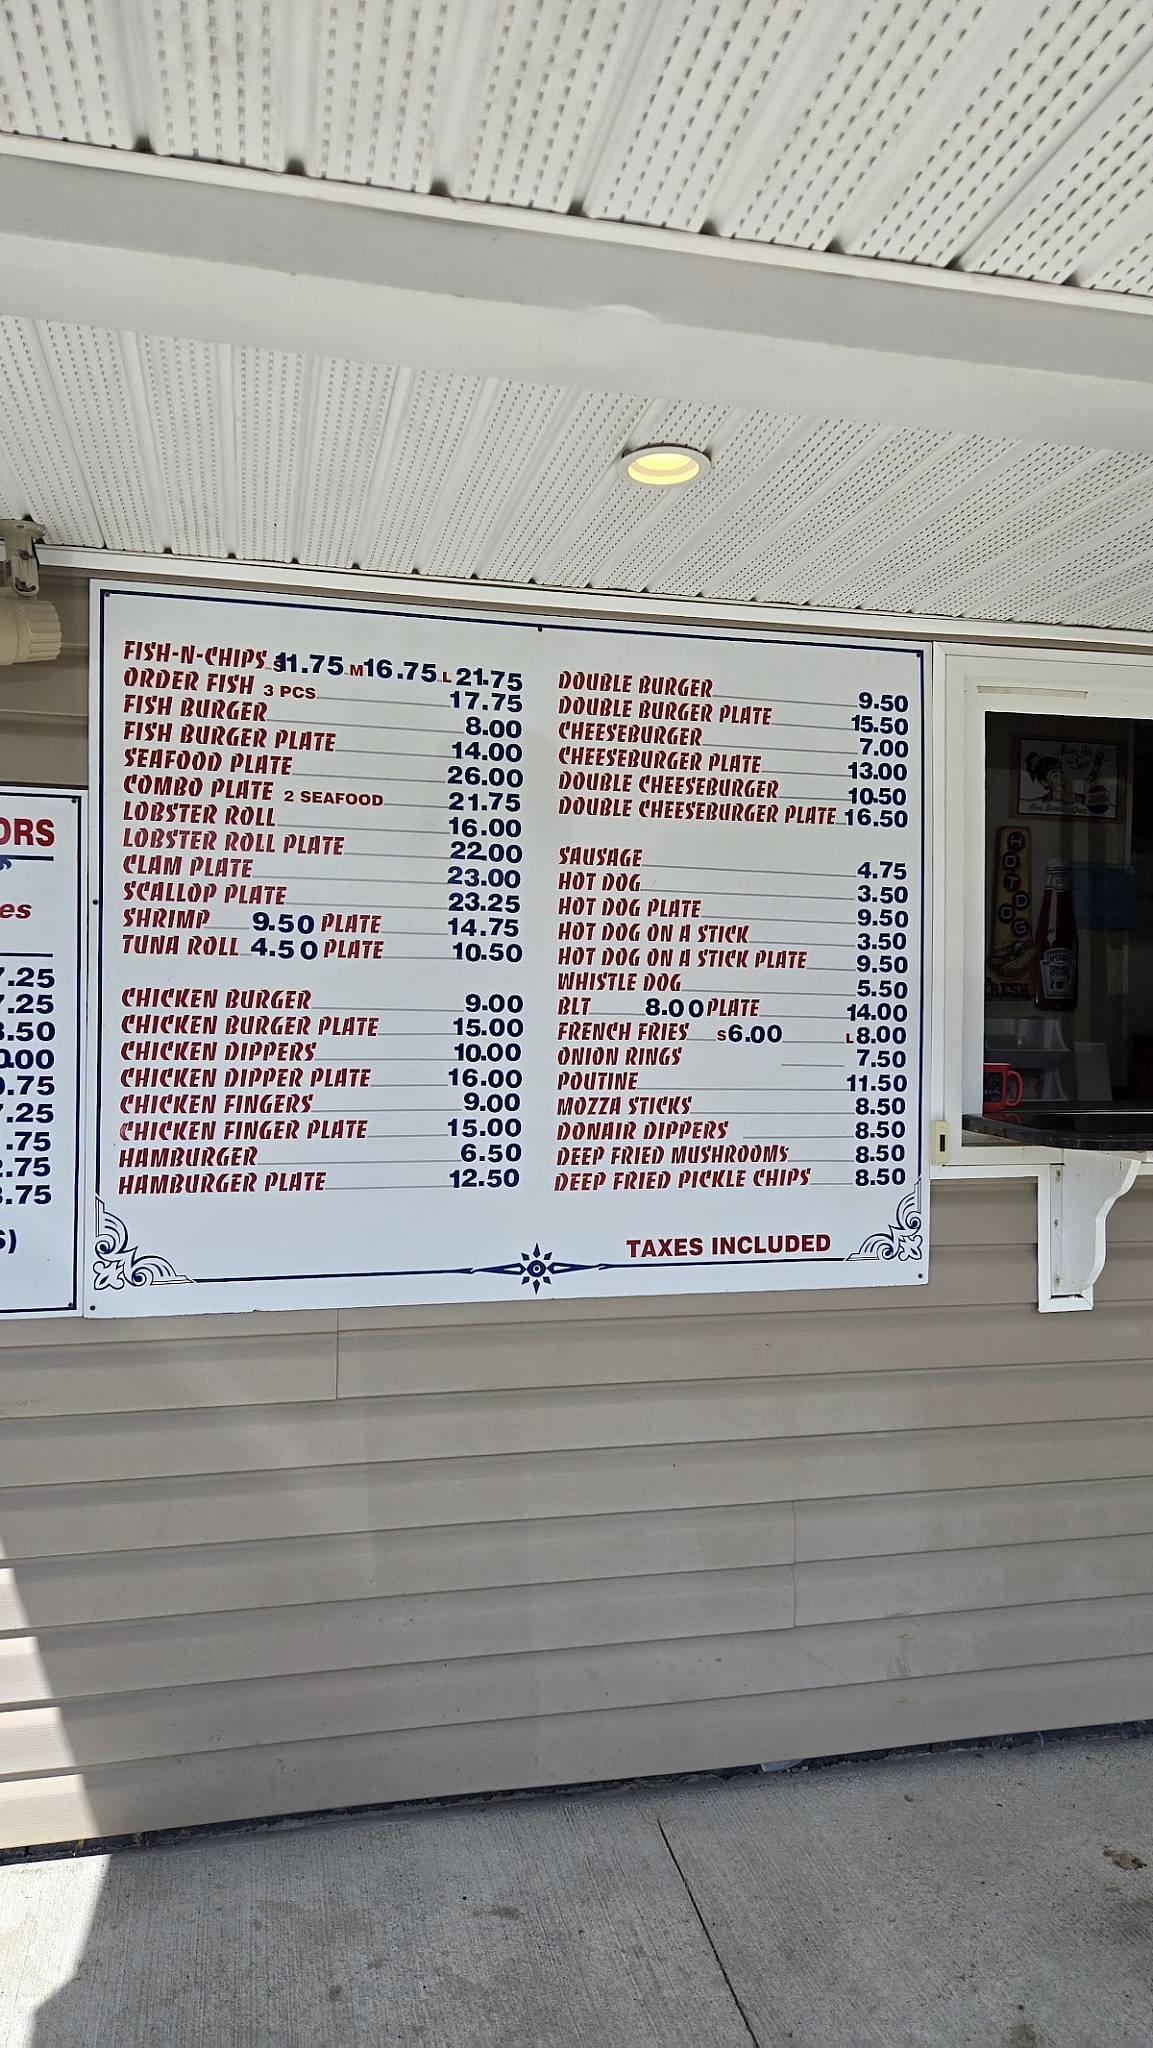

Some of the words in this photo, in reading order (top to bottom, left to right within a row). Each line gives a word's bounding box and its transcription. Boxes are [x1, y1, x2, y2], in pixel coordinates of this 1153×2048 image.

[124, 641, 267, 668] FISH-N-CHIPS
[124, 668, 198, 691] ORDER
[207, 674, 254, 694] FISH
[264, 685, 273, 696] 3
[280, 686, 315, 699] PCS
[450, 691, 522, 712] 17.75
[559, 671, 632, 692] DOUBLE
[639, 676, 712, 697] BURGER
[859, 692, 908, 712] 9.50
[124, 695, 172, 715] FISH
[180, 698, 268, 721] BURGER
[466, 717, 521, 738] 8.00
[559, 696, 632, 717] DOUBLE
[639, 701, 712, 722] BURGER
[720, 705, 771, 725] PLATE
[852, 715, 908, 735] 15.50
[124, 721, 172, 742] FISH
[180, 724, 267, 747] BURGER
[275, 730, 335, 752] PLATE
[452, 742, 522, 762] 14.00
[559, 721, 701, 746] CHEESEBURGER
[860, 738, 908, 757] 7.00
[124, 748, 222, 771] SEAFOOD
[231, 753, 292, 775] PLATE
[448, 766, 523, 787] 26.00
[559, 747, 701, 770] CHEESEBURGER
[709, 753, 761, 773] PLATE
[848, 762, 907, 781] 13.00
[124, 775, 202, 796] COMBO
[211, 779, 273, 800] PLATE
[285, 791, 293, 801] 2
[301, 791, 383, 805] SEAFOOD
[449, 792, 520, 812] 21.75
[559, 772, 632, 792] DOUBLE
[639, 775, 778, 798] CHEESEBURGER
[849, 788, 906, 805] 10.50
[124, 801, 217, 824] LOBSTER
[225, 806, 275, 826] ROLL
[449, 817, 521, 837] 16.00
[559, 797, 632, 816] DOUBLE
[639, 800, 778, 822] CHEESEBURGER
[785, 805, 836, 824] PLATE
[845, 808, 908, 828] 16.50
[124, 828, 217, 850] LOBSTER
[225, 832, 275, 852] ROLL
[284, 834, 344, 854] PLATE
[124, 855, 182, 875] CLAM
[190, 857, 253, 877] PLATE
[448, 866, 520, 888] 23.00
[559, 847, 642, 866] SAUSAGE
[858, 861, 906, 880] 4.75
[124, 881, 217, 902] SCALLOP
[224, 884, 286, 904] PLATE
[449, 892, 520, 913] 23.25
[559, 872, 596, 890] HOT
[602, 873, 640, 891] DOG
[858, 885, 908, 903] 3.50
[124, 908, 209, 928] SHRIMP
[253, 912, 314, 934] 9.50
[321, 913, 381, 933] PLATE
[448, 918, 518, 937] 14.75
[559, 896, 596, 915] HOT
[602, 898, 640, 916] DOG
[648, 899, 700, 917] PLATE
[858, 909, 908, 928] 9.50
[123, 935, 179, 954] TUNA
[188, 936, 238, 956] ROLL
[251, 938, 318, 960] 4.50
[324, 939, 383, 959] PLATE
[453, 942, 522, 962] 10.50
[559, 922, 596, 940] HOT
[602, 923, 640, 941] DOG
[648, 924, 673, 942] ON
[679, 924, 691, 942] A
[698, 925, 748, 943] STICK
[857, 933, 906, 950] 3.50
[558, 947, 595, 965] HOT
[602, 948, 639, 966] DOG
[648, 949, 673, 966] ON
[679, 949, 690, 966] A
[698, 949, 748, 967] STICK
[755, 950, 806, 968] PLATE
[857, 955, 908, 973] 9.50
[559, 972, 637, 990] WHISTLE
[644, 974, 680, 991] DOG
[857, 980, 907, 999] 5.50
[122, 988, 218, 1008] CHICKEN
[226, 989, 311, 1009] BURGER
[466, 994, 523, 1013] 9.00
[558, 997, 590, 1015] BLT
[646, 998, 703, 1018] 8.00
[707, 998, 759, 1016] PLATE
[847, 1003, 907, 1022] 14.00
[122, 1015, 217, 1034] CHICKEN
[226, 1015, 311, 1035] BURGER
[318, 1017, 378, 1036] PLATE
[453, 1018, 523, 1037] 15.00
[558, 1022, 631, 1040] FRENCH
[638, 1022, 689, 1040] FRIES
[121, 1041, 217, 1060] CHICKEN
[225, 1040, 316, 1061] DIPPERS
[455, 1043, 521, 1062] 10.00
[558, 1047, 619, 1065] ONION
[625, 1047, 682, 1065] RINGS
[857, 1049, 906, 1068] 7.50
[120, 1068, 216, 1087] CHICKEN
[225, 1068, 303, 1087] DIPPER
[311, 1068, 370, 1087] PLATE
[449, 1068, 522, 1088] 16.00
[558, 1072, 638, 1090] POUTINE
[847, 1074, 907, 1092] 11.50
[120, 1095, 216, 1113] CHICKEN
[224, 1094, 313, 1113] FINGERS
[464, 1093, 520, 1113] 9.00
[558, 1097, 620, 1115] MOZZA
[629, 1097, 692, 1114] STICKS
[856, 1098, 905, 1115] 8.50
[120, 1121, 216, 1140] CHICKEN
[224, 1120, 299, 1139] FINGER
[307, 1120, 367, 1138] PLATE
[448, 1118, 521, 1137] 15.00
[557, 1121, 636, 1140] DONAIR
[644, 1120, 728, 1139] DIPPERS
[856, 1121, 905, 1139] 8.50
[120, 1147, 257, 1167] HAMBURGER
[461, 1144, 521, 1162] 6.50
[557, 1147, 604, 1165] DEEP
[611, 1146, 664, 1164] FRIED
[672, 1145, 787, 1163] MUSHROOMS
[856, 1145, 904, 1163] 8.50
[119, 1172, 257, 1194] HAMBURGER
[265, 1172, 326, 1191] PLATE
[450, 1169, 519, 1188] 12.50
[555, 1172, 606, 1191] DEEP
[614, 1171, 671, 1189] FRIED
[679, 1169, 746, 1188] PICKLE
[754, 1168, 810, 1186] CHIPS
[856, 1168, 905, 1186] 8.50
[627, 1238, 702, 1257] TAXES
[713, 1235, 830, 1254] INCLUDED
